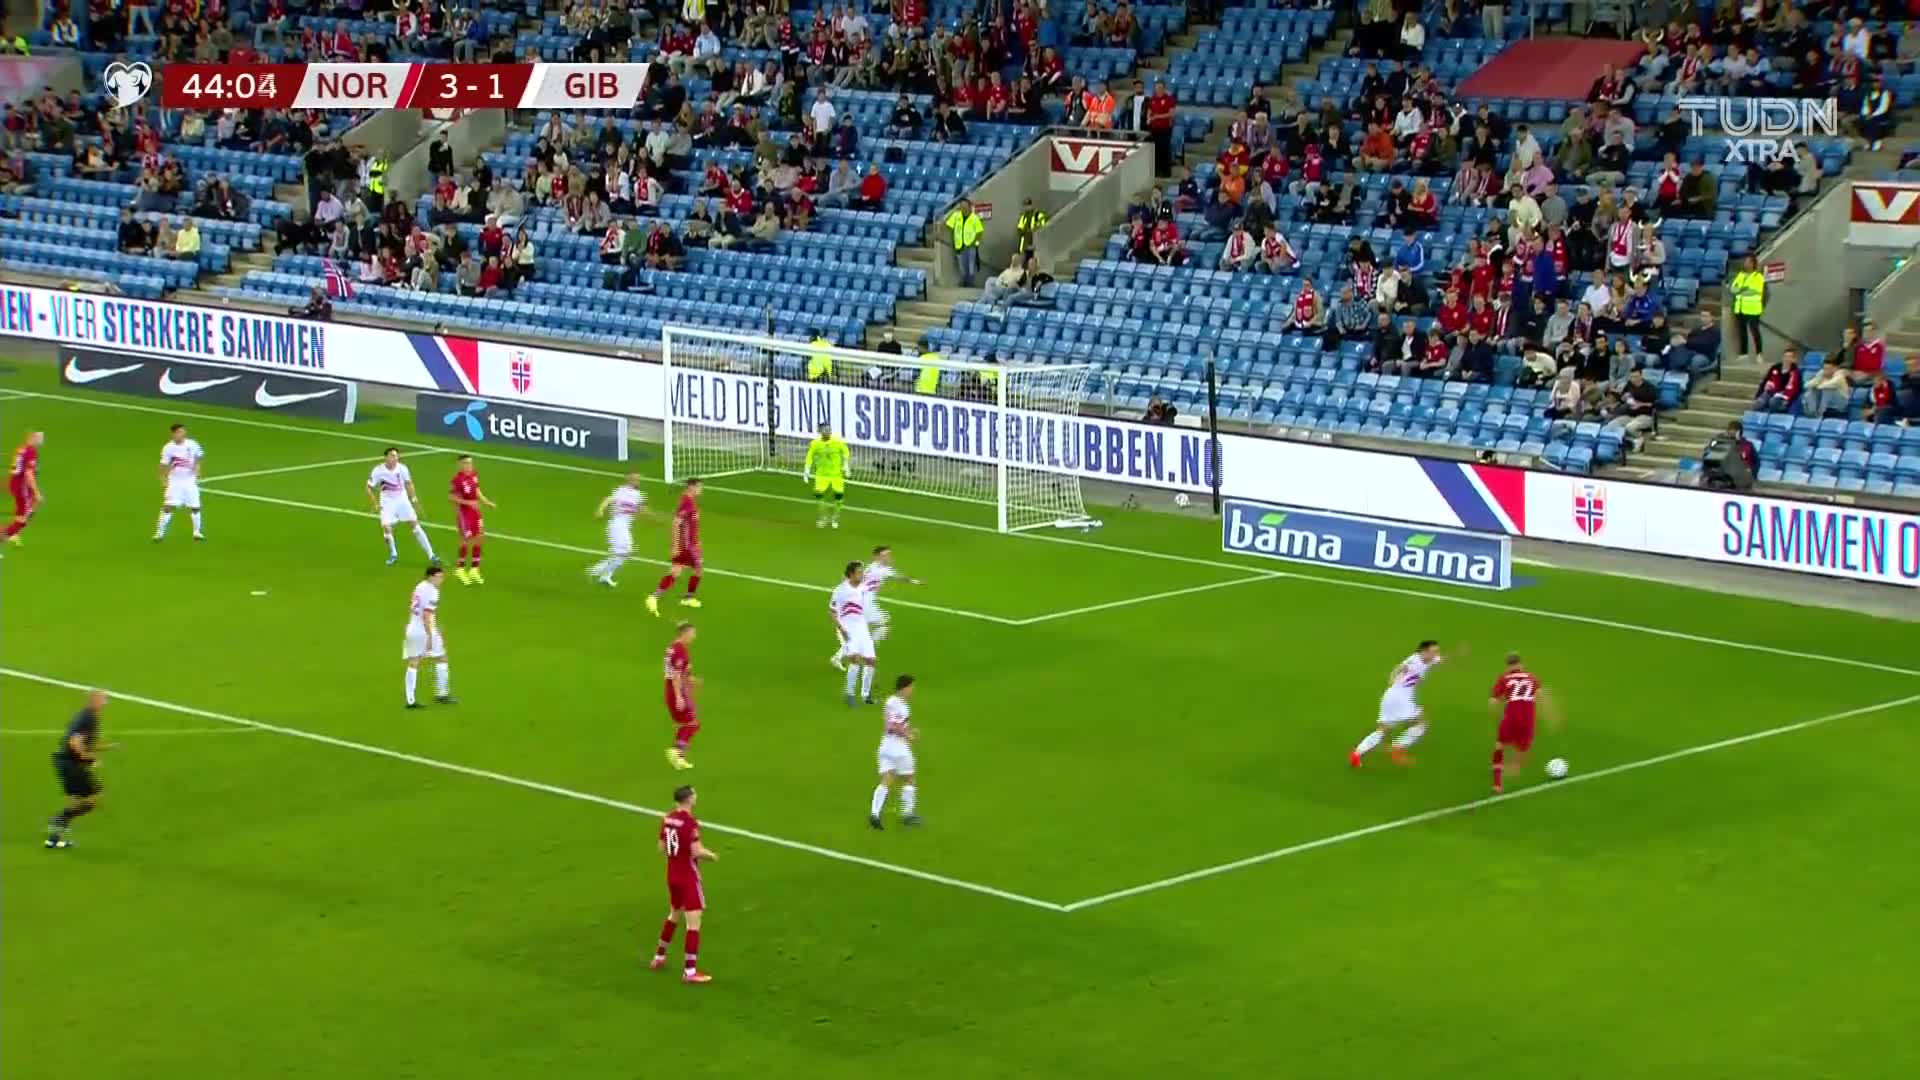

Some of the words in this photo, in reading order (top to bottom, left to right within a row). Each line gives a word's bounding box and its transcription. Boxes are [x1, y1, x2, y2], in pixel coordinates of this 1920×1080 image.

[104, 301, 214, 355] STERKERE
[221, 315, 325, 369] SAMMEN
[488, 412, 591, 448] telenor
[1229, 509, 1342, 561] bama
[1374, 530, 1494, 583] bama
[1722, 500, 1885, 575] SAMMEN
[1505, 679, 1535, 701] 22
[664, 827, 679, 856] 19
